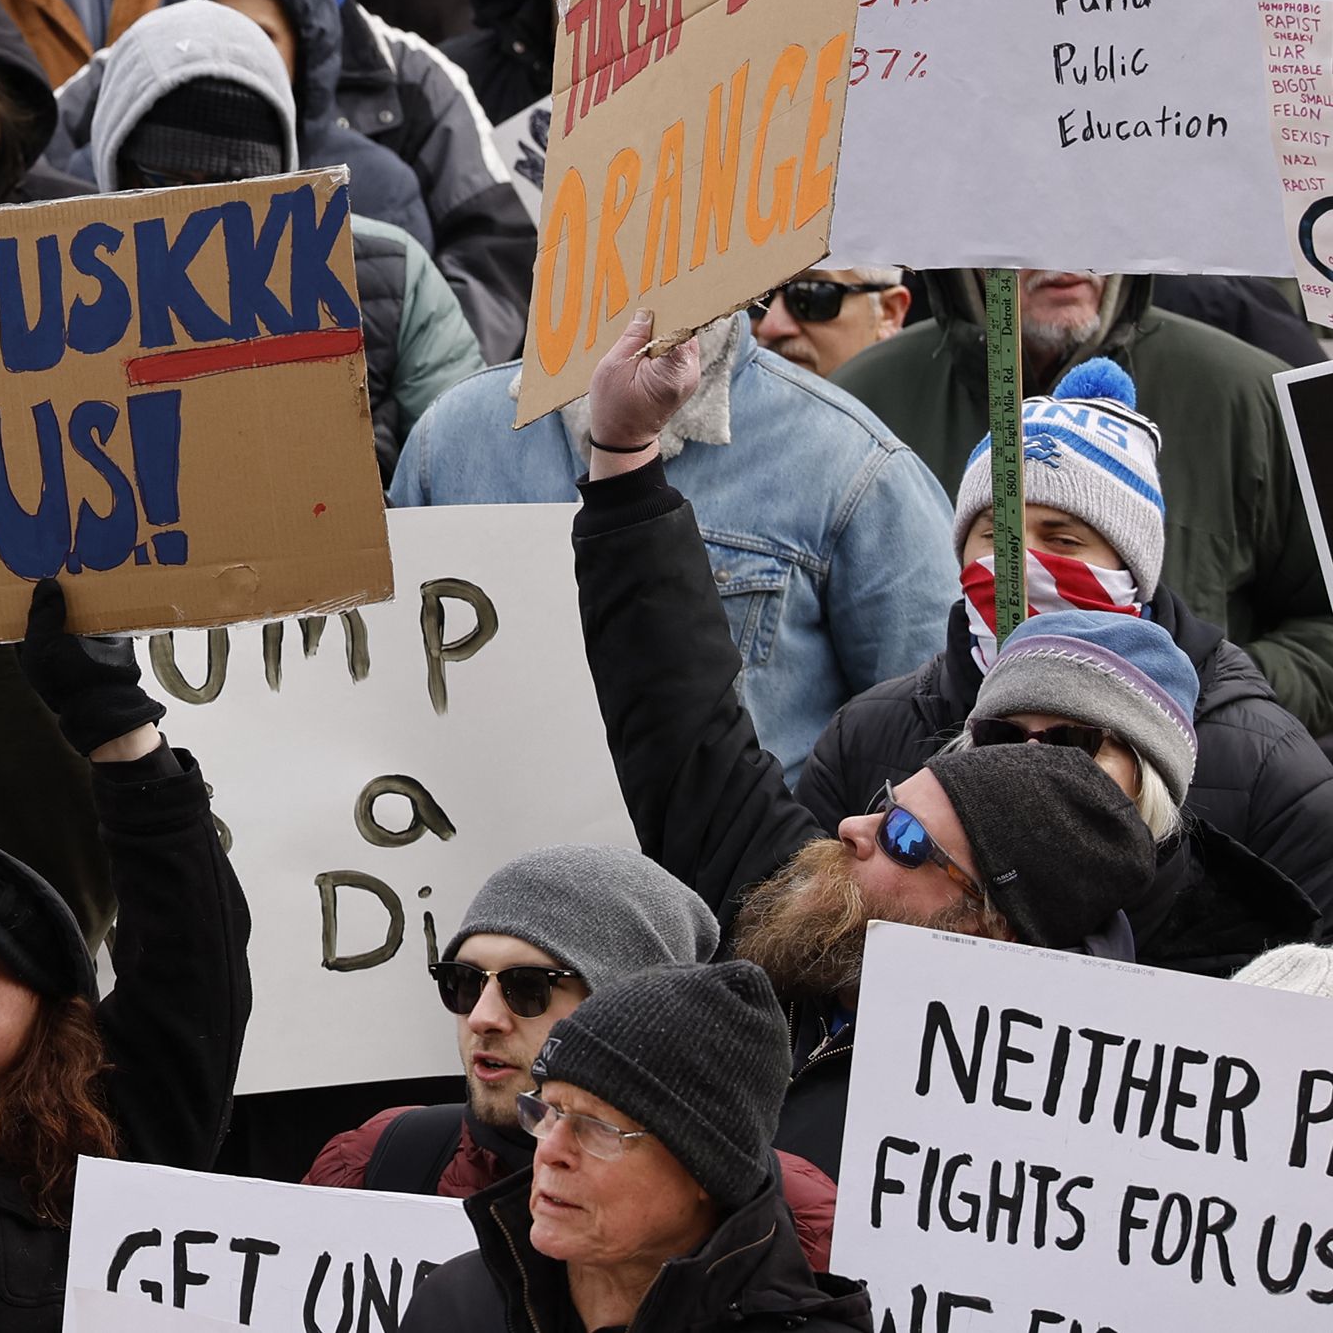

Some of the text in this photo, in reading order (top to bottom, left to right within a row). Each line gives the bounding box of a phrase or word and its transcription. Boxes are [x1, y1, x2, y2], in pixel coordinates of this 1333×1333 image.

[1258, 2, 1321, 14] HOMOPHOBIC
[1265, 14, 1321, 32] RAPIST
[1273, 32, 1313, 44] SNEAKY
[1269, 45, 1305, 59] LIAR
[1053, 42, 1150, 86] Public
[1268, 65, 1323, 75] UNSTABLE
[1272, 78, 1317, 94] BIGOT
[1273, 103, 1321, 120] FELON
[1058, 106, 1228, 148] Education
[1281, 128, 1331, 147] SEXIST
[1282, 155, 1317, 166] NAZI
[1283, 178, 1325, 192] RACIST
[535, 32, 849, 377] ORANGE
[1301, 284, 1331, 298] CREEP
[1001, 298, 1013, 336] Detroit
[1003, 366, 1014, 383] Rd.
[1004, 390, 1015, 412] Mile
[1005, 420, 1017, 446] Eight
[1005, 452, 1016, 463] E.
[1006, 469, 1017, 497] 5800
[353, 774, 457, 849] a
[914, 1000, 1261, 1162] NEITHER
[870, 1135, 1095, 1252] FIGHTS
[1117, 1185, 1237, 1287] FOR
